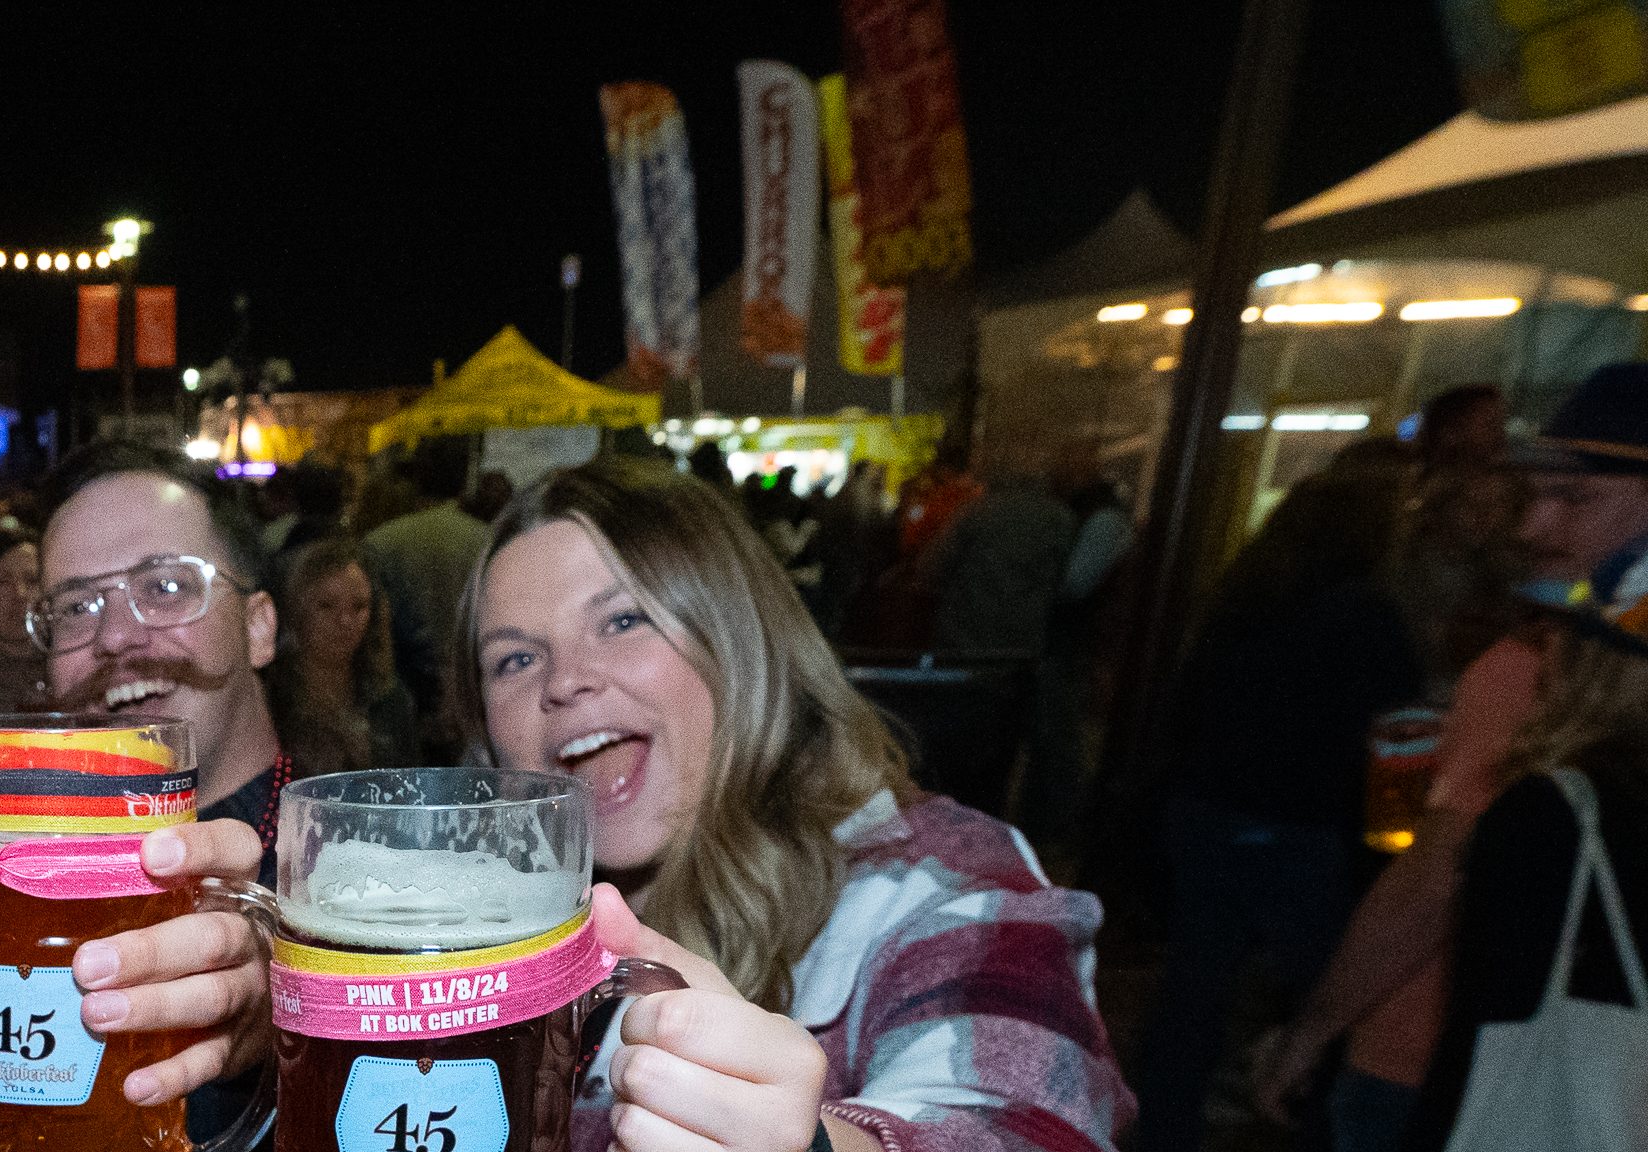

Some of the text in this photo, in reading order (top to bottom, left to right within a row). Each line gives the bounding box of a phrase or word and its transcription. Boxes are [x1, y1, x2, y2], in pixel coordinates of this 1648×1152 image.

[161, 776, 193, 792] ZEECO
[420, 971, 509, 1005] 11/8/24
[360, 1003, 499, 1033] AT BOK CENTER
[3, 1085, 46, 1095] TULSA
